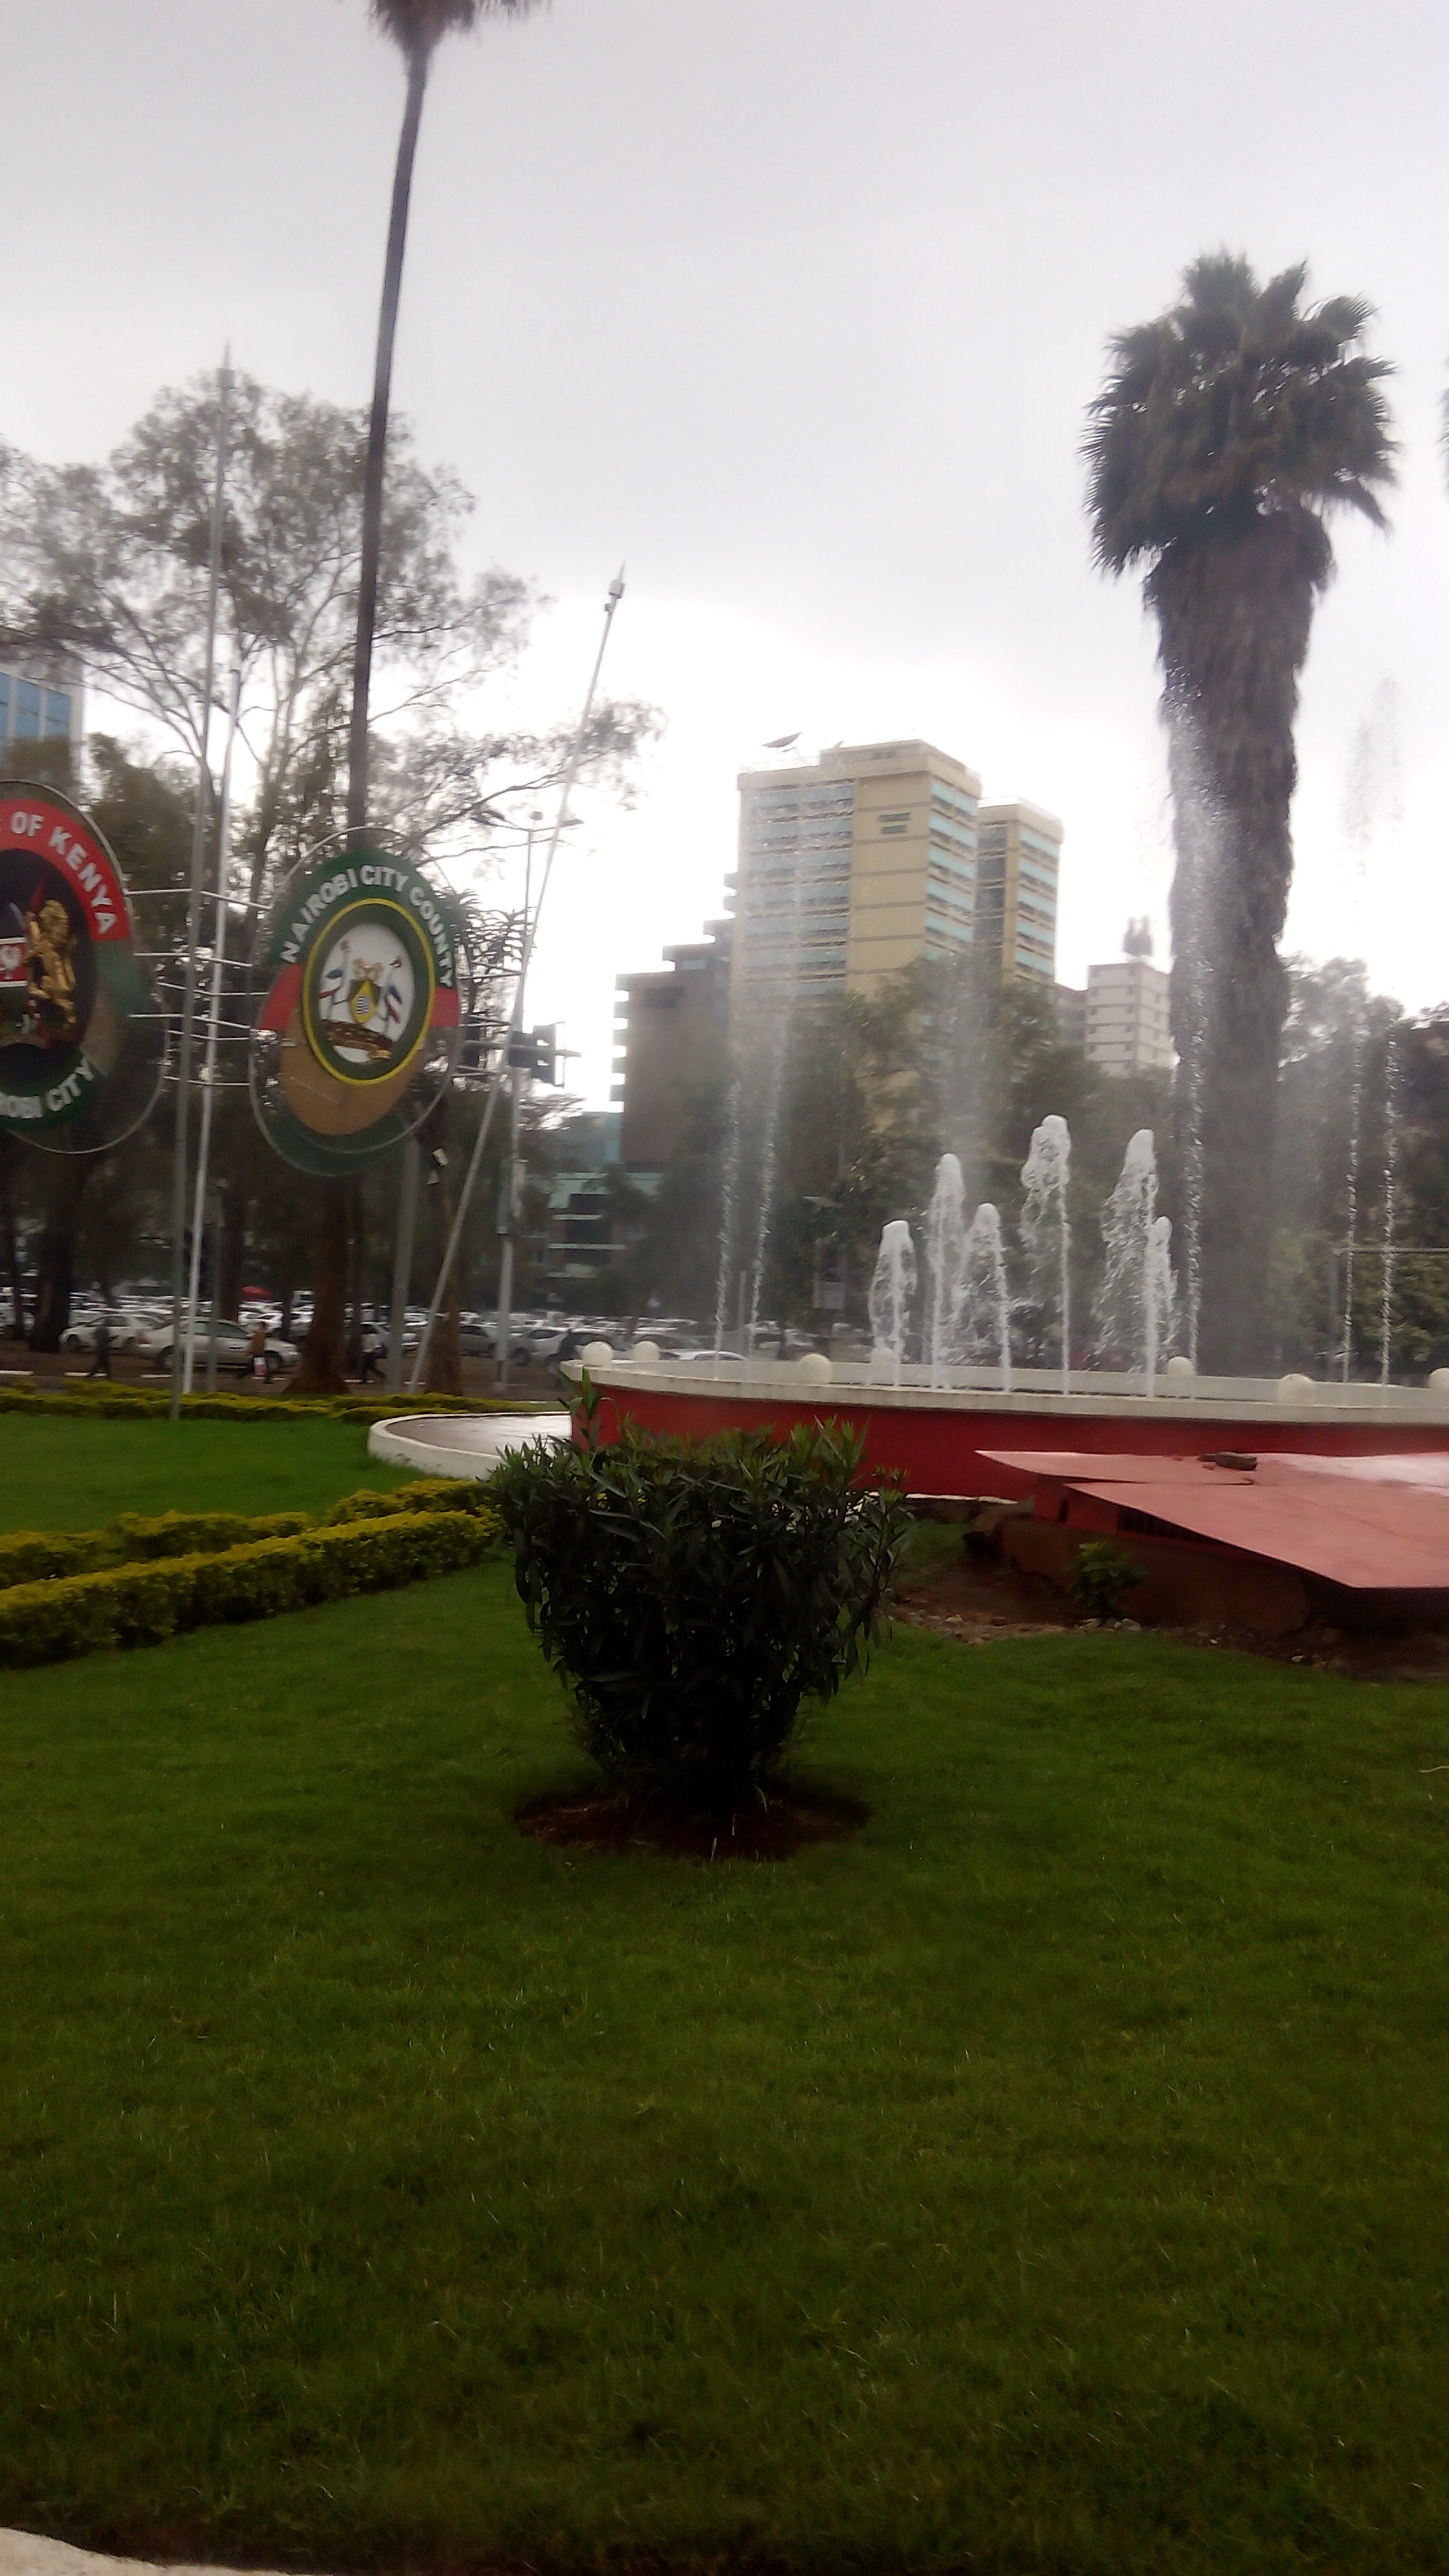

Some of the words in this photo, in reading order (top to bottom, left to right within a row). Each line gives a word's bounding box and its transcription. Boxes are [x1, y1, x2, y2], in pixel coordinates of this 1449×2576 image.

[10, 810, 45, 837] OF
[48, 826, 118, 935] KENYA
[279, 867, 359, 964] NAIROBI
[360, 864, 409, 892] CITY
[409, 885, 453, 988] COUNTY
[44, 1057, 95, 1112] CITY
